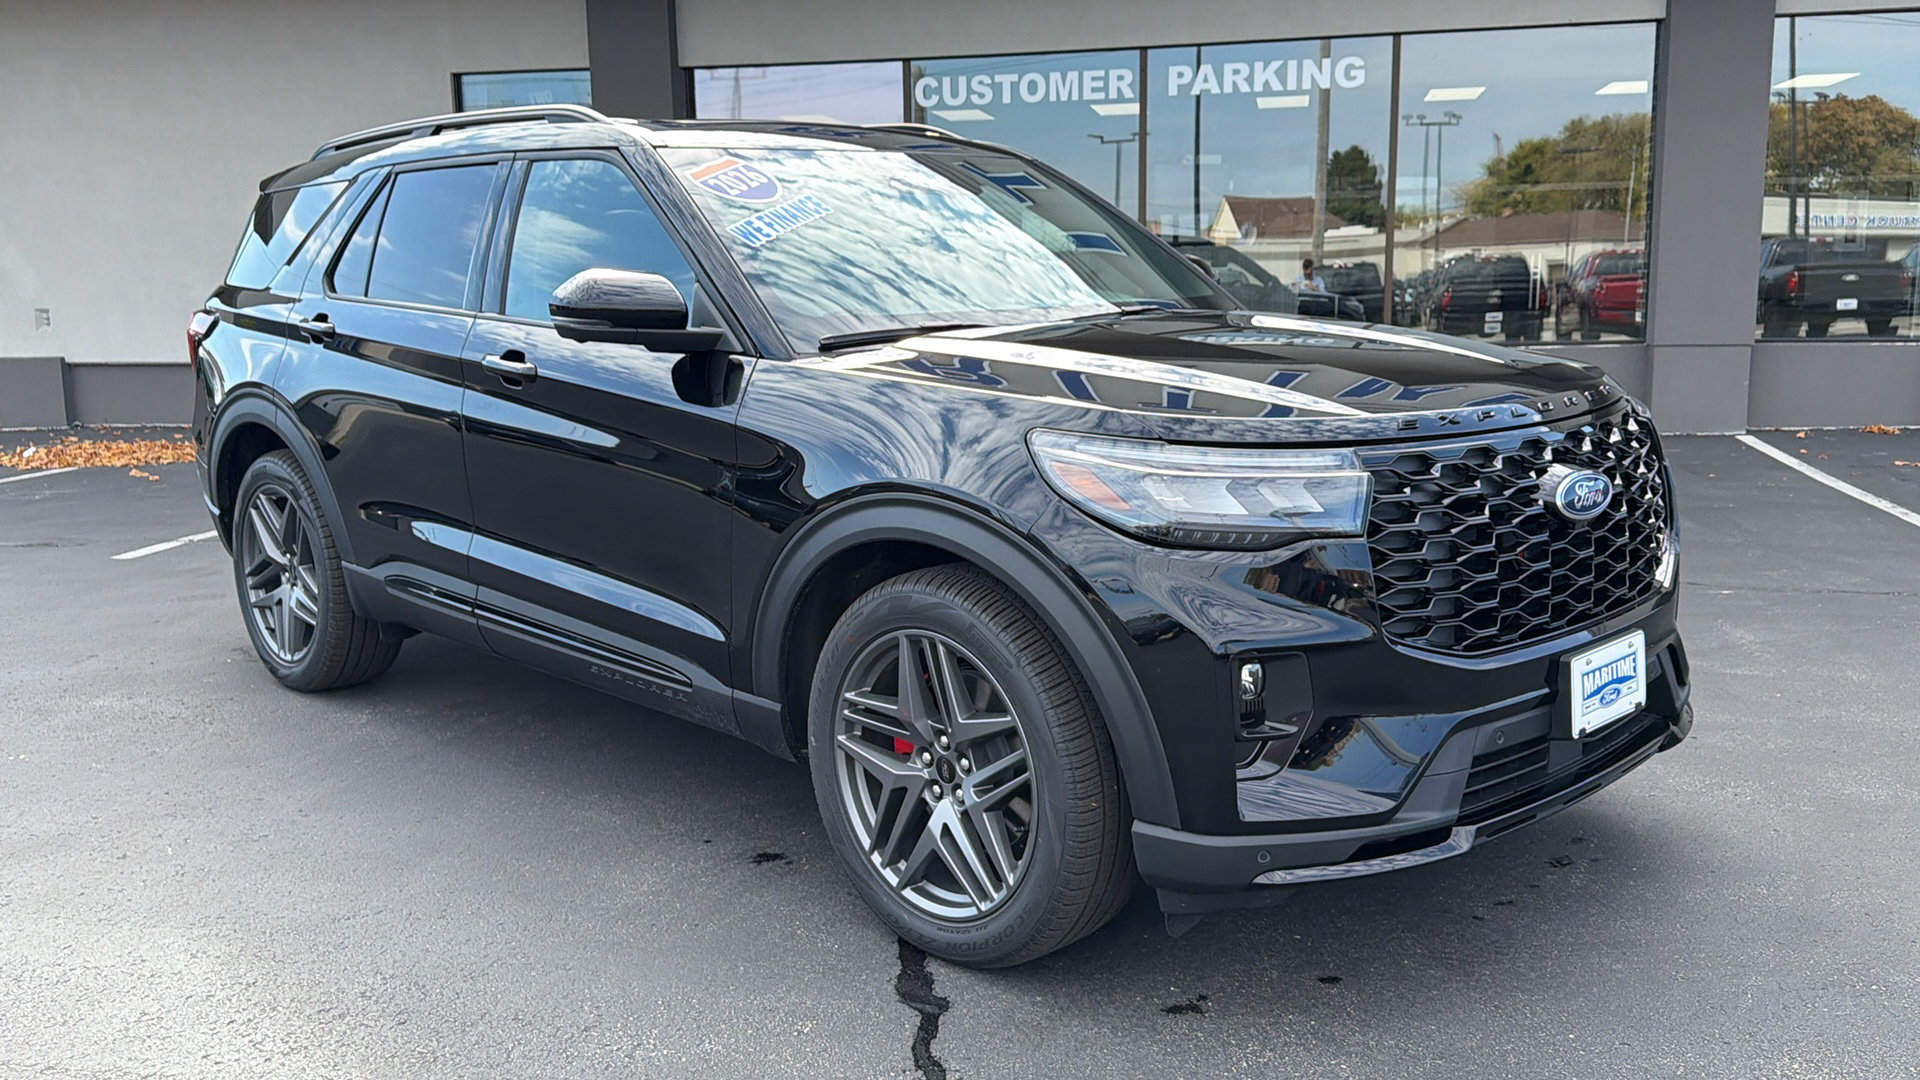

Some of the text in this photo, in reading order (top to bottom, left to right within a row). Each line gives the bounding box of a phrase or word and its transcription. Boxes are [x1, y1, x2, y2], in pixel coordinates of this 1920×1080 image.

[914, 56, 1367, 108] CUSTOMER PARKING
[706, 165, 769, 197] 2026
[729, 195, 831, 246] WE FINANCE
[1397, 385, 1612, 431] EXPLORER
[1574, 480, 1606, 509] Ford
[1583, 654, 1636, 700] MARITIME
